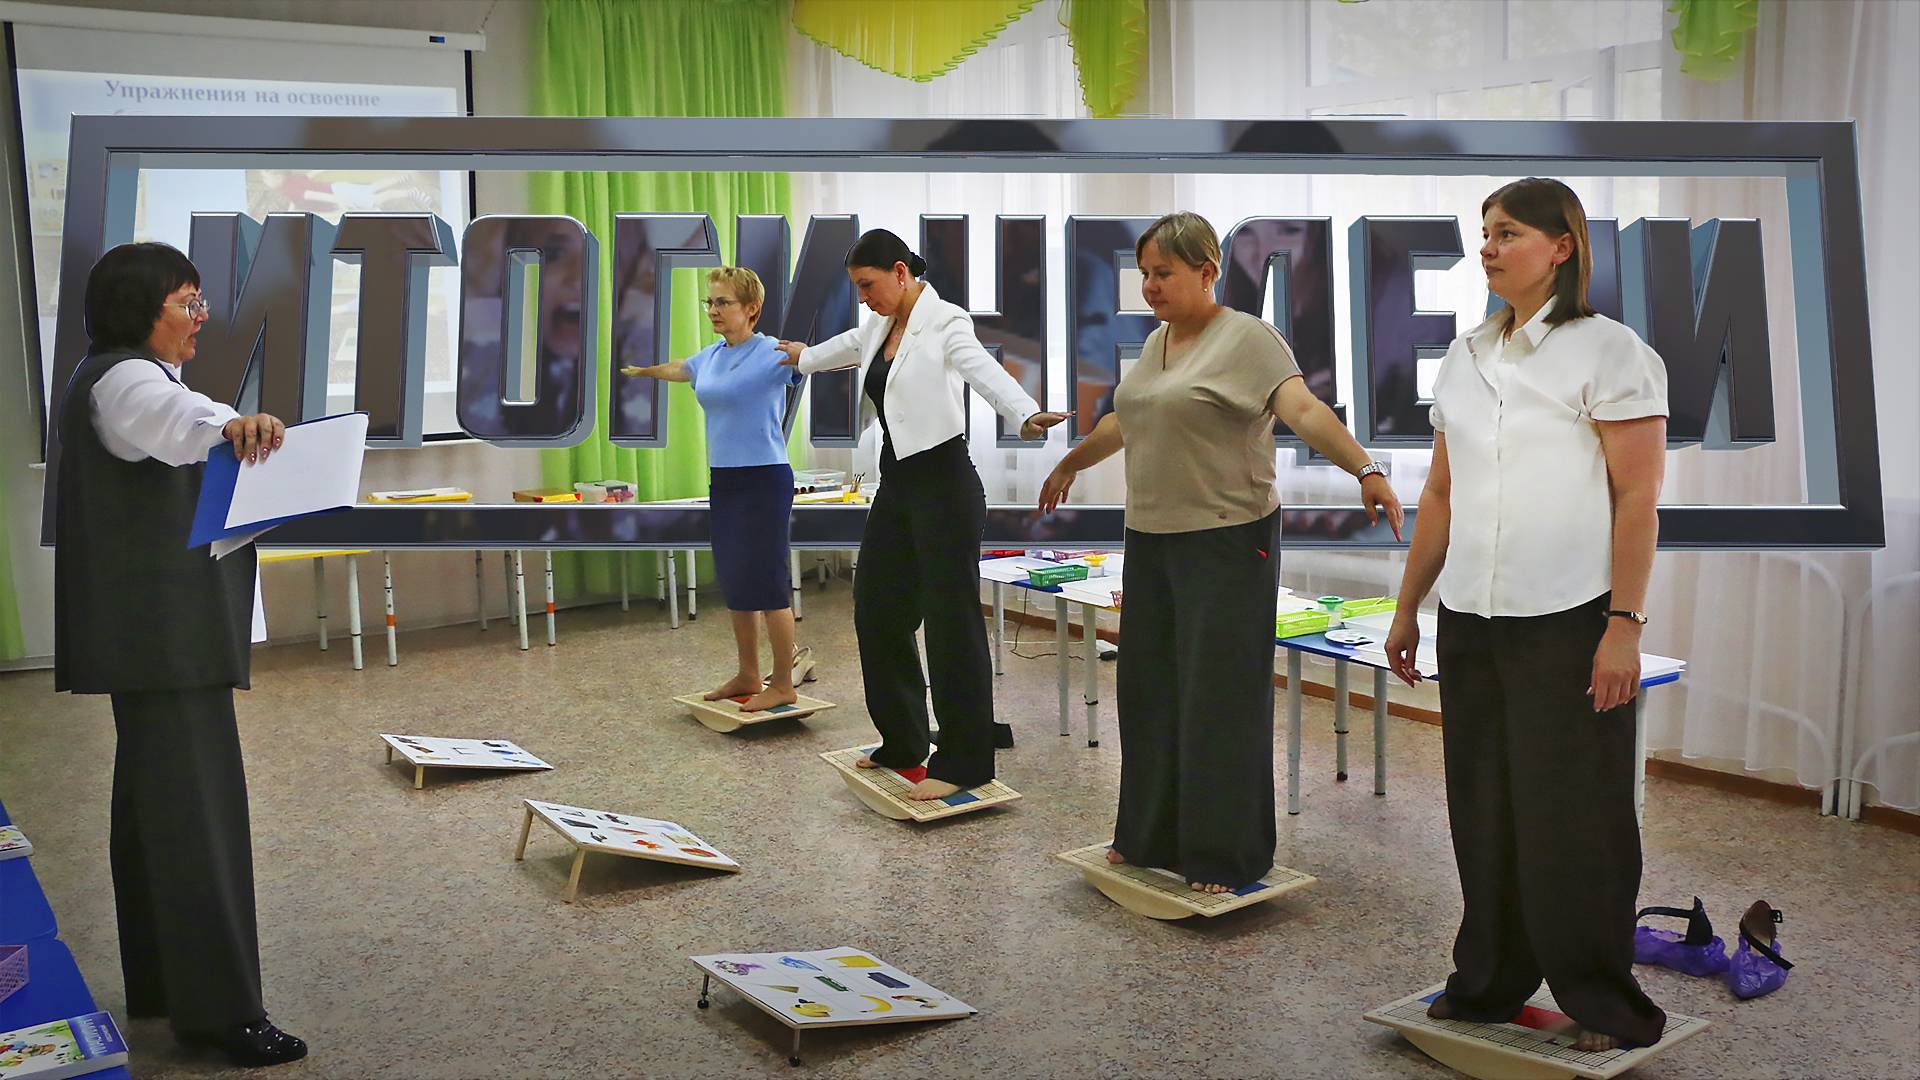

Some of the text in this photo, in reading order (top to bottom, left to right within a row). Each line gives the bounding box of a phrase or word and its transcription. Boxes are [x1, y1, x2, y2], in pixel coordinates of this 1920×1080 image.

[104, 79, 380, 107] Упражнения на освоение
